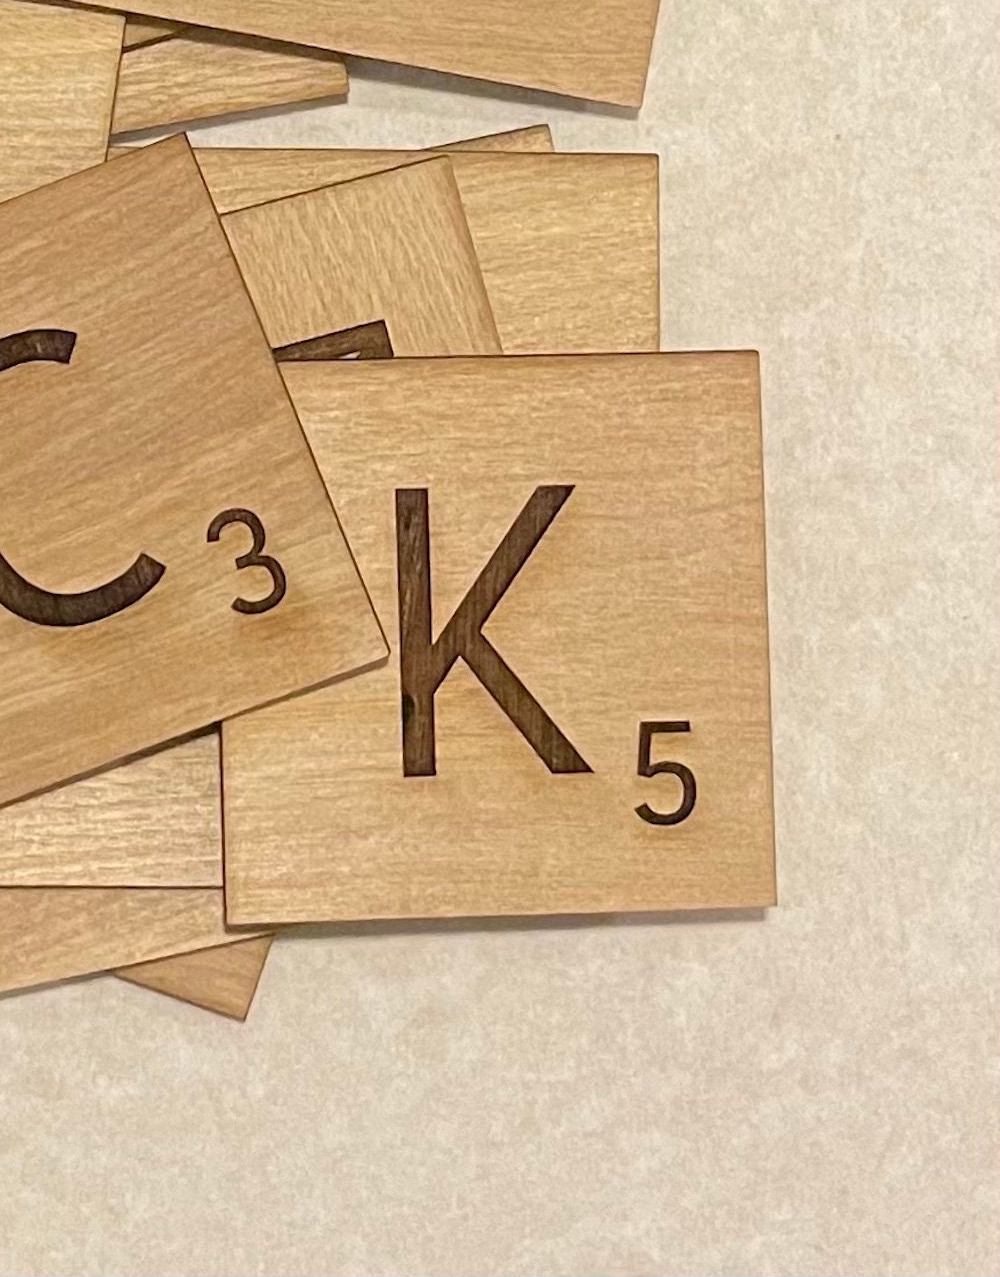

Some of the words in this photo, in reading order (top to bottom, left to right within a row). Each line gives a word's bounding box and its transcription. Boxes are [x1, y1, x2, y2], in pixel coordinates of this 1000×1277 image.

[206, 508, 287, 616] 3
[396, 484, 595, 778] K
[635, 720, 697, 826] 5
